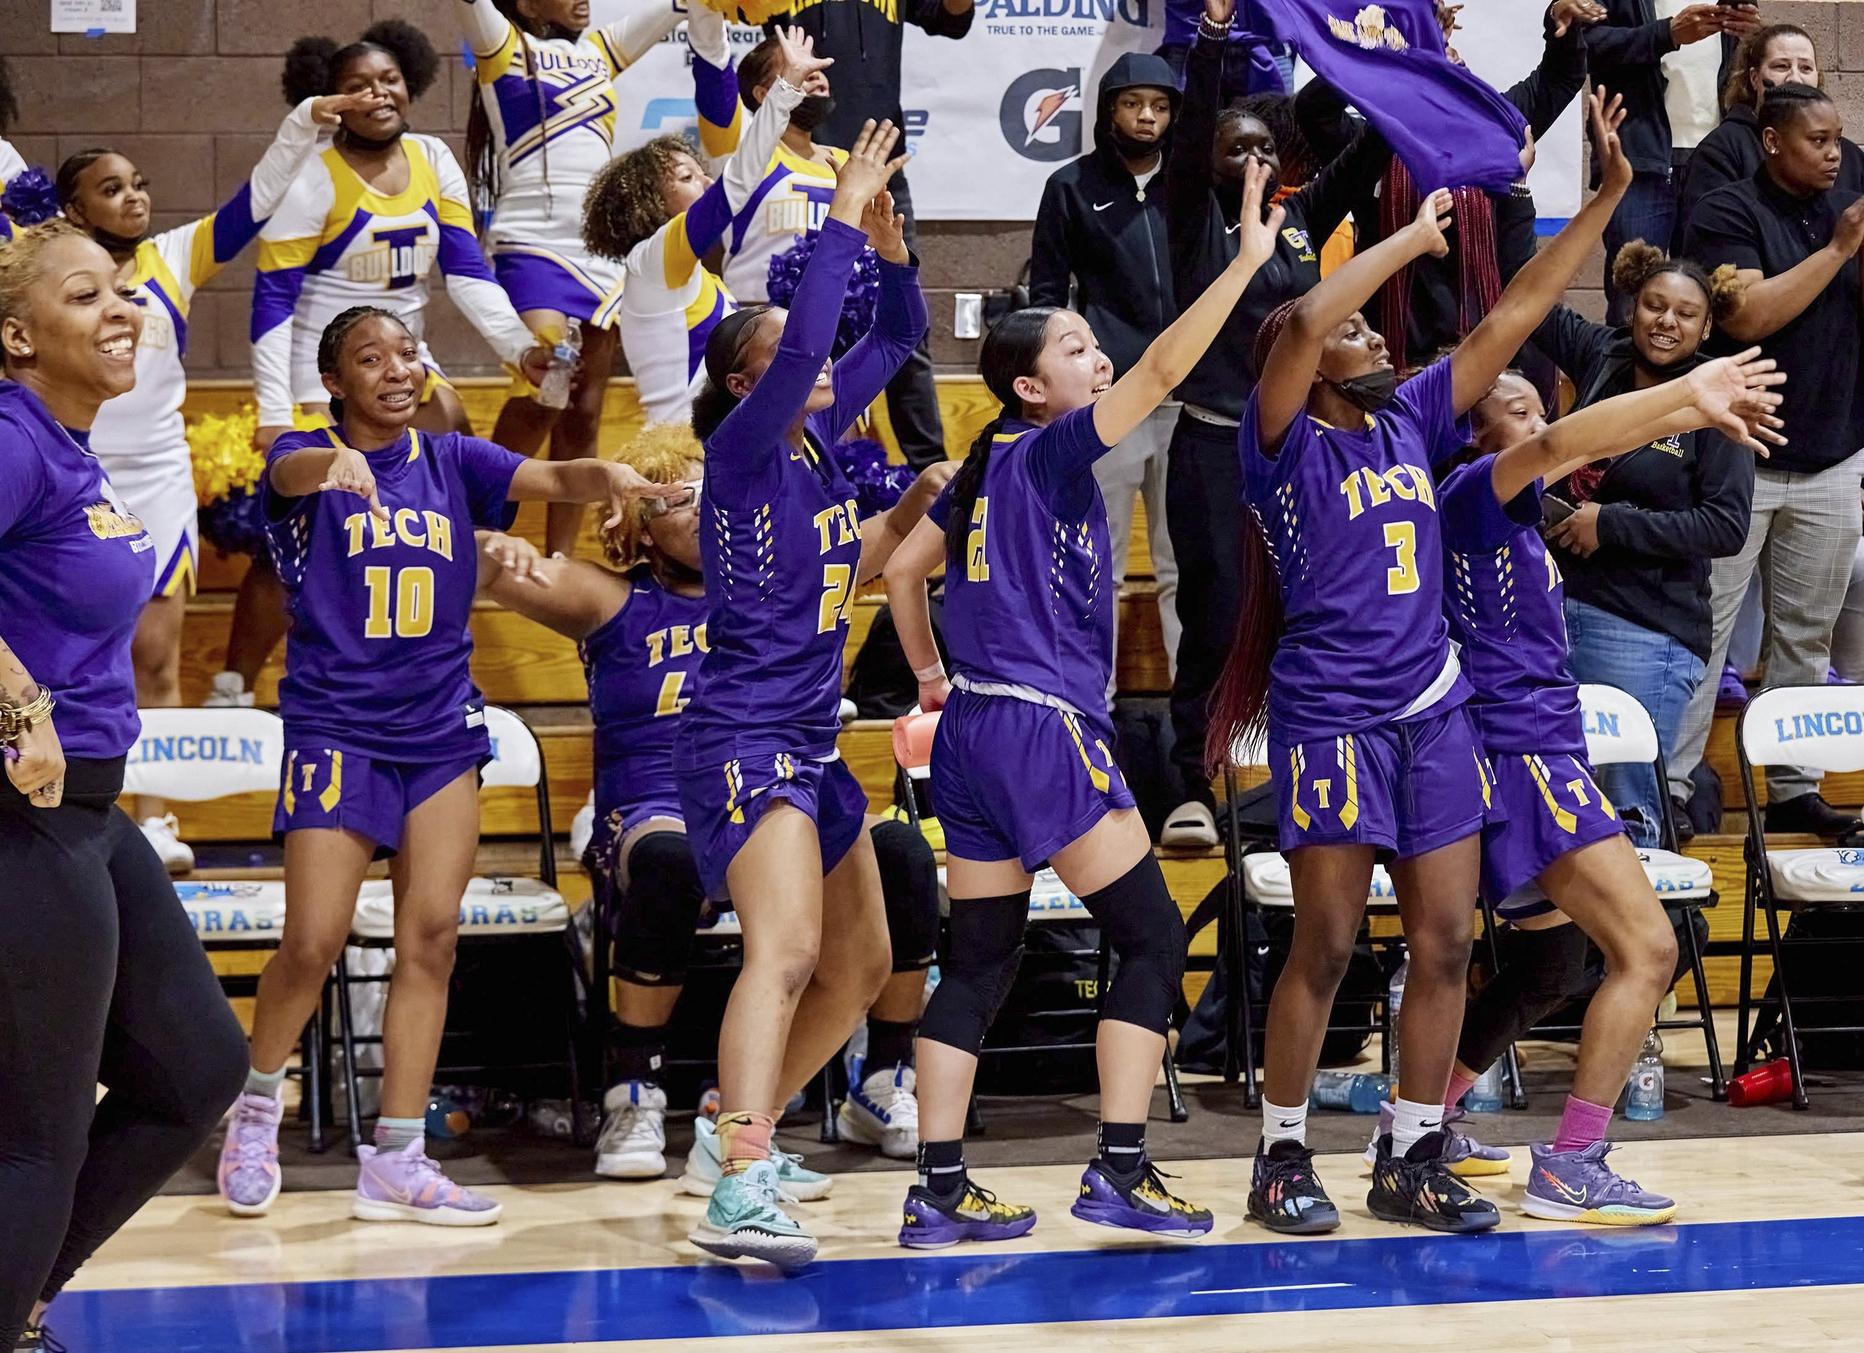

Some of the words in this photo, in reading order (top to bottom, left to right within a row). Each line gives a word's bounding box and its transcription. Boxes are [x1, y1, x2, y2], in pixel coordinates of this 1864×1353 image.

[975, 0, 1150, 28] ALDING
[987, 25, 1016, 36] TRUE
[1020, 25, 1034, 36] TO
[1037, 26, 1058, 36] THE
[1061, 26, 1095, 36] GAME
[1651, 441, 1684, 458] Basketball
[1340, 463, 1436, 520] TECH
[343, 506, 453, 562] TECH
[813, 499, 862, 555] TEC
[1383, 521, 1420, 595] 3
[364, 566, 435, 638] 10
[645, 623, 712, 668] TEC
[1775, 711, 1864, 743] LINCO
[128, 735, 263, 764] INCOLN
[302, 763, 317, 792] T
[1566, 778, 1591, 807] T
[1312, 778, 1331, 809] T
